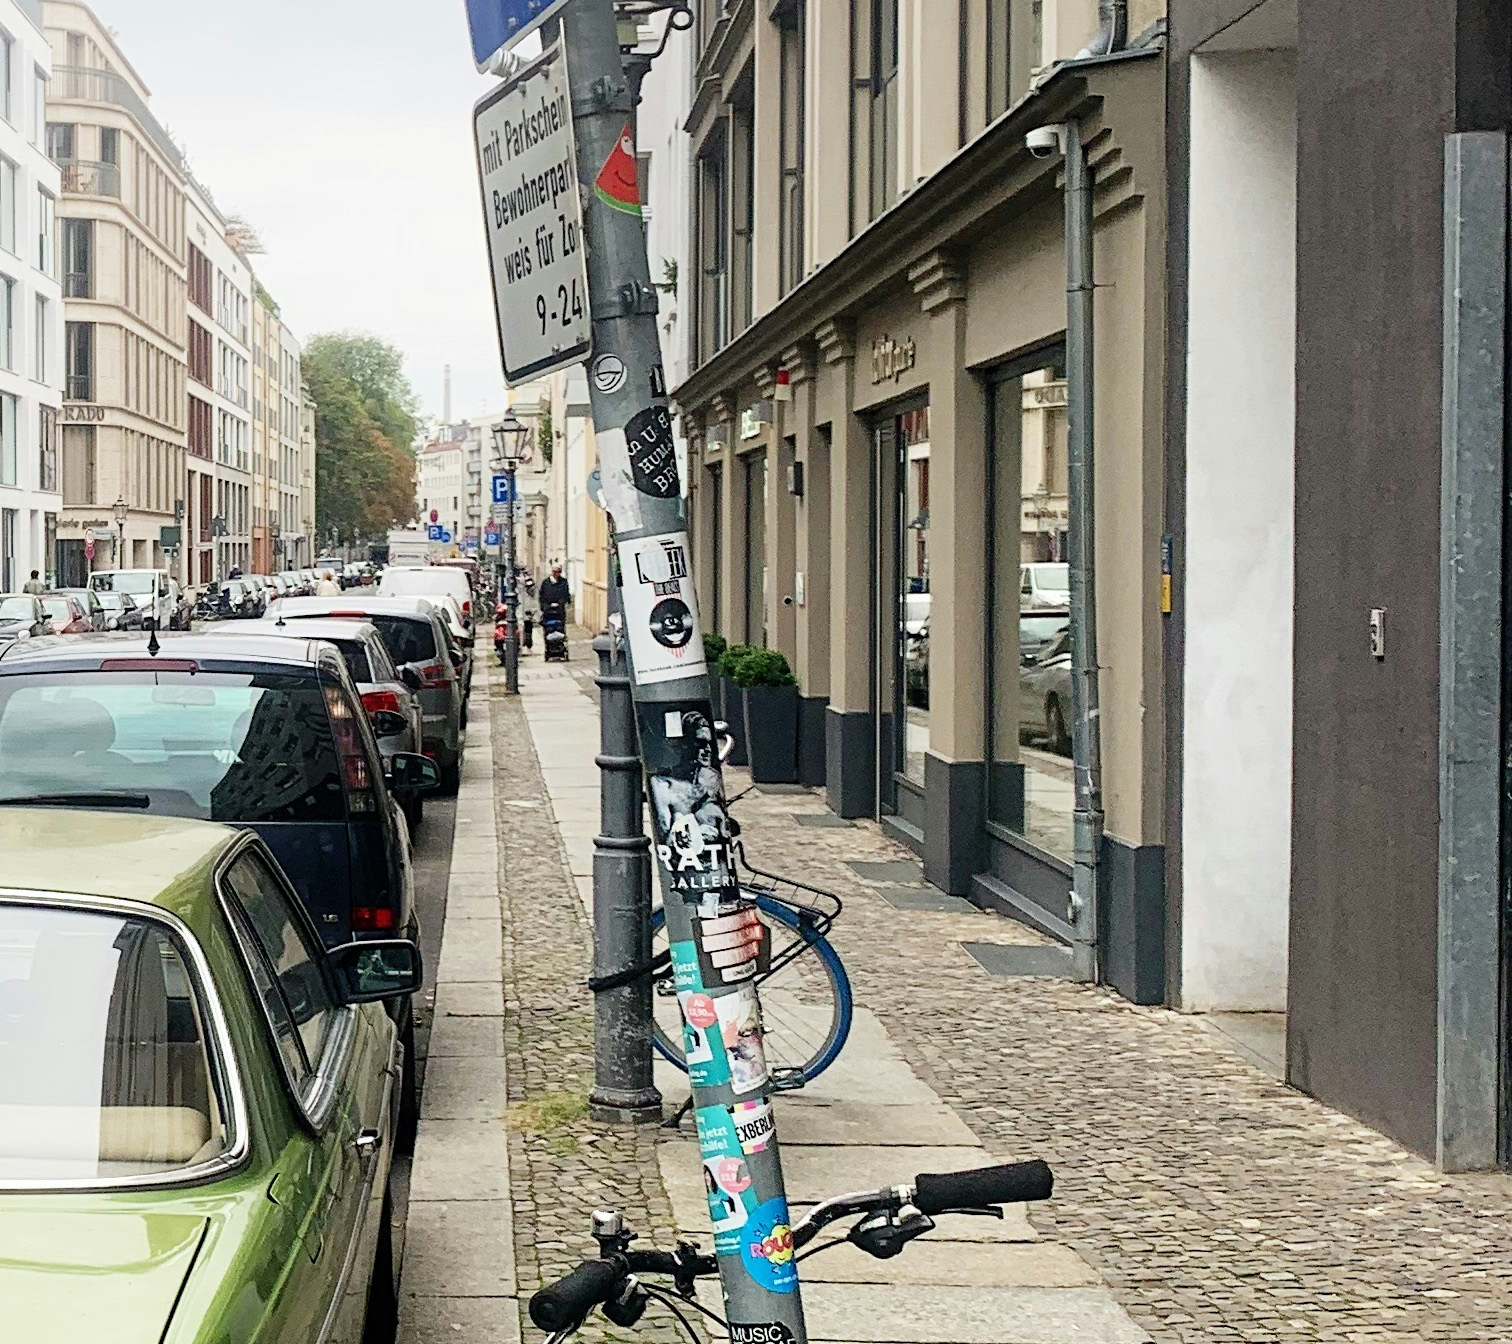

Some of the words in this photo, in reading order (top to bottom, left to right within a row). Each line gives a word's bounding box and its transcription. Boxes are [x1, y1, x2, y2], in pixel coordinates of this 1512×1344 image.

[482, 130, 503, 176] mit
[504, 237, 533, 285] weis
[536, 223, 555, 269] für
[558, 213, 580, 257] Zo
[65, 406, 105, 422] RADO
[731, 1325, 782, 1343] MUSIC
